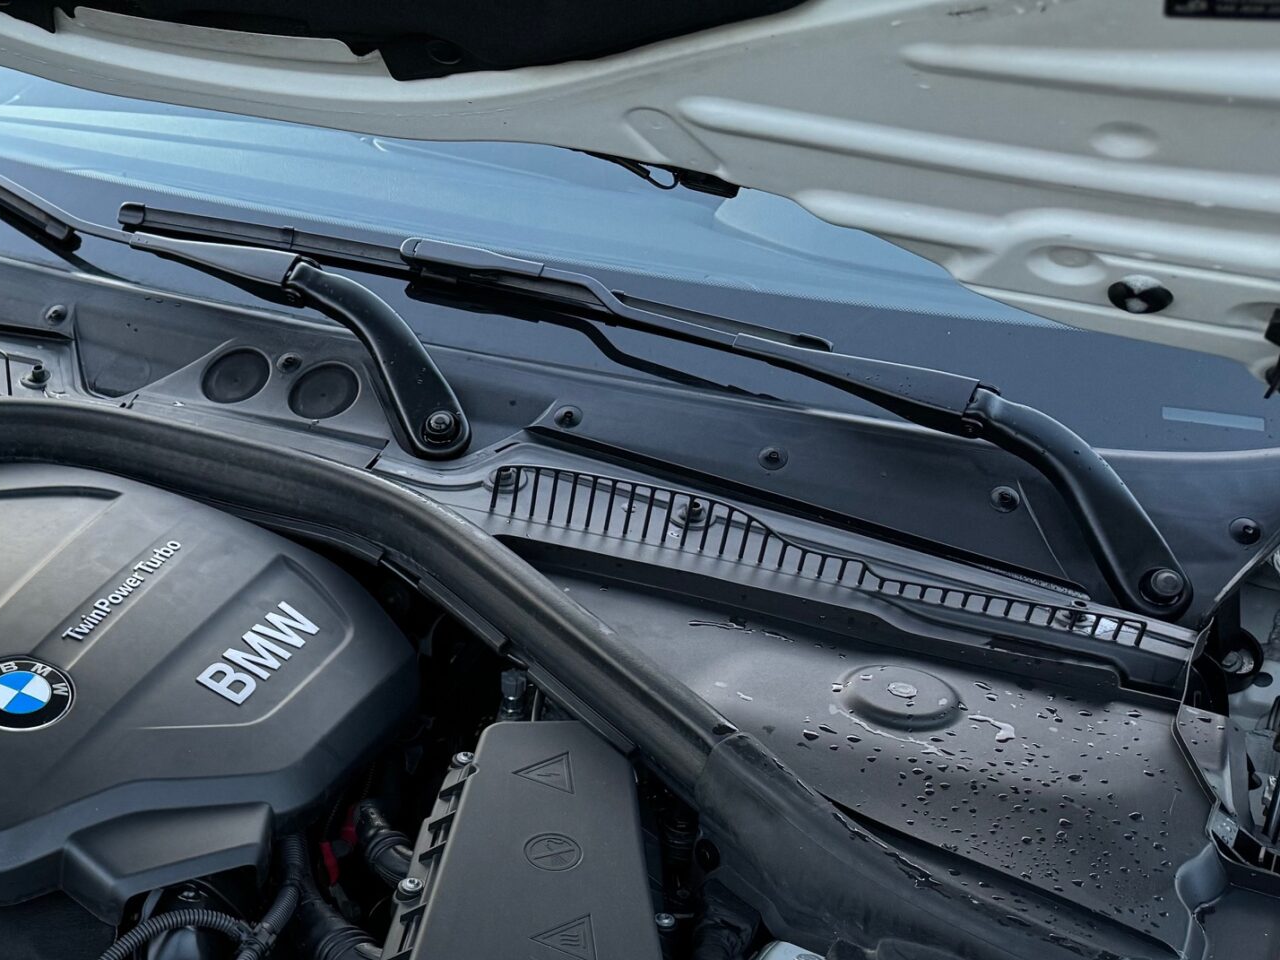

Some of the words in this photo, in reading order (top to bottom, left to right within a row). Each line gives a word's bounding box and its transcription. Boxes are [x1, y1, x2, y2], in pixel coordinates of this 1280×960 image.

[61, 571, 145, 642] TwinPower
[134, 539, 181, 576] Turbo
[0, 661, 69, 696] BMW
[195, 600, 320, 706] BMW
